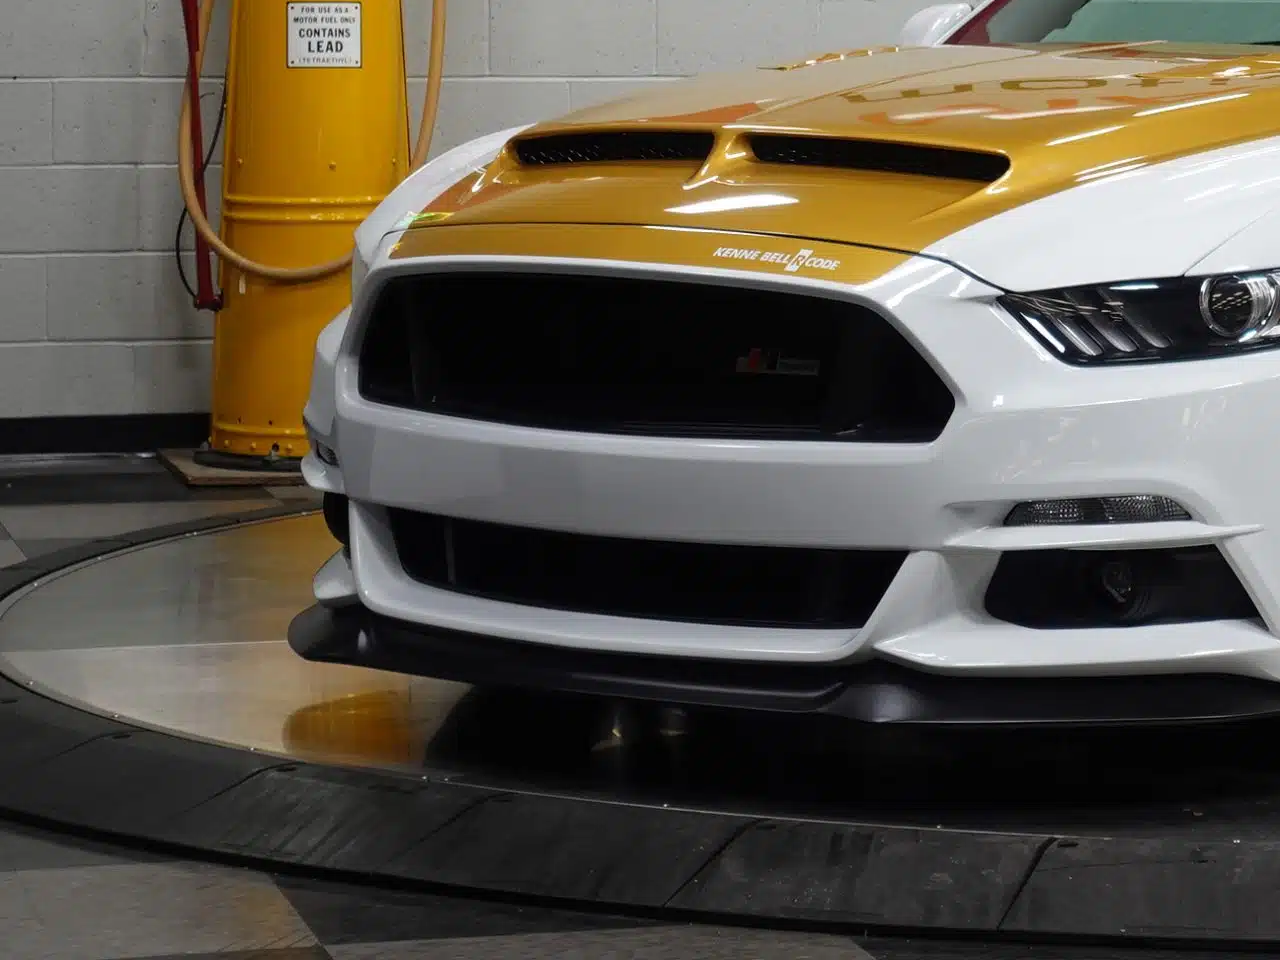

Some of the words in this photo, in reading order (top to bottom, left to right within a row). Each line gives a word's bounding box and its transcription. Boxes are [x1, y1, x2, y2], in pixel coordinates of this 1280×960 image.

[293, 16, 318, 24] MOTOR
[321, 16, 338, 24] FUEL
[298, 27, 351, 38] CONTAINS
[308, 40, 343, 53] LEAD
[713, 246, 761, 260] KENNE
[760, 251, 791, 264] BELL
[805, 257, 841, 271] CODE
